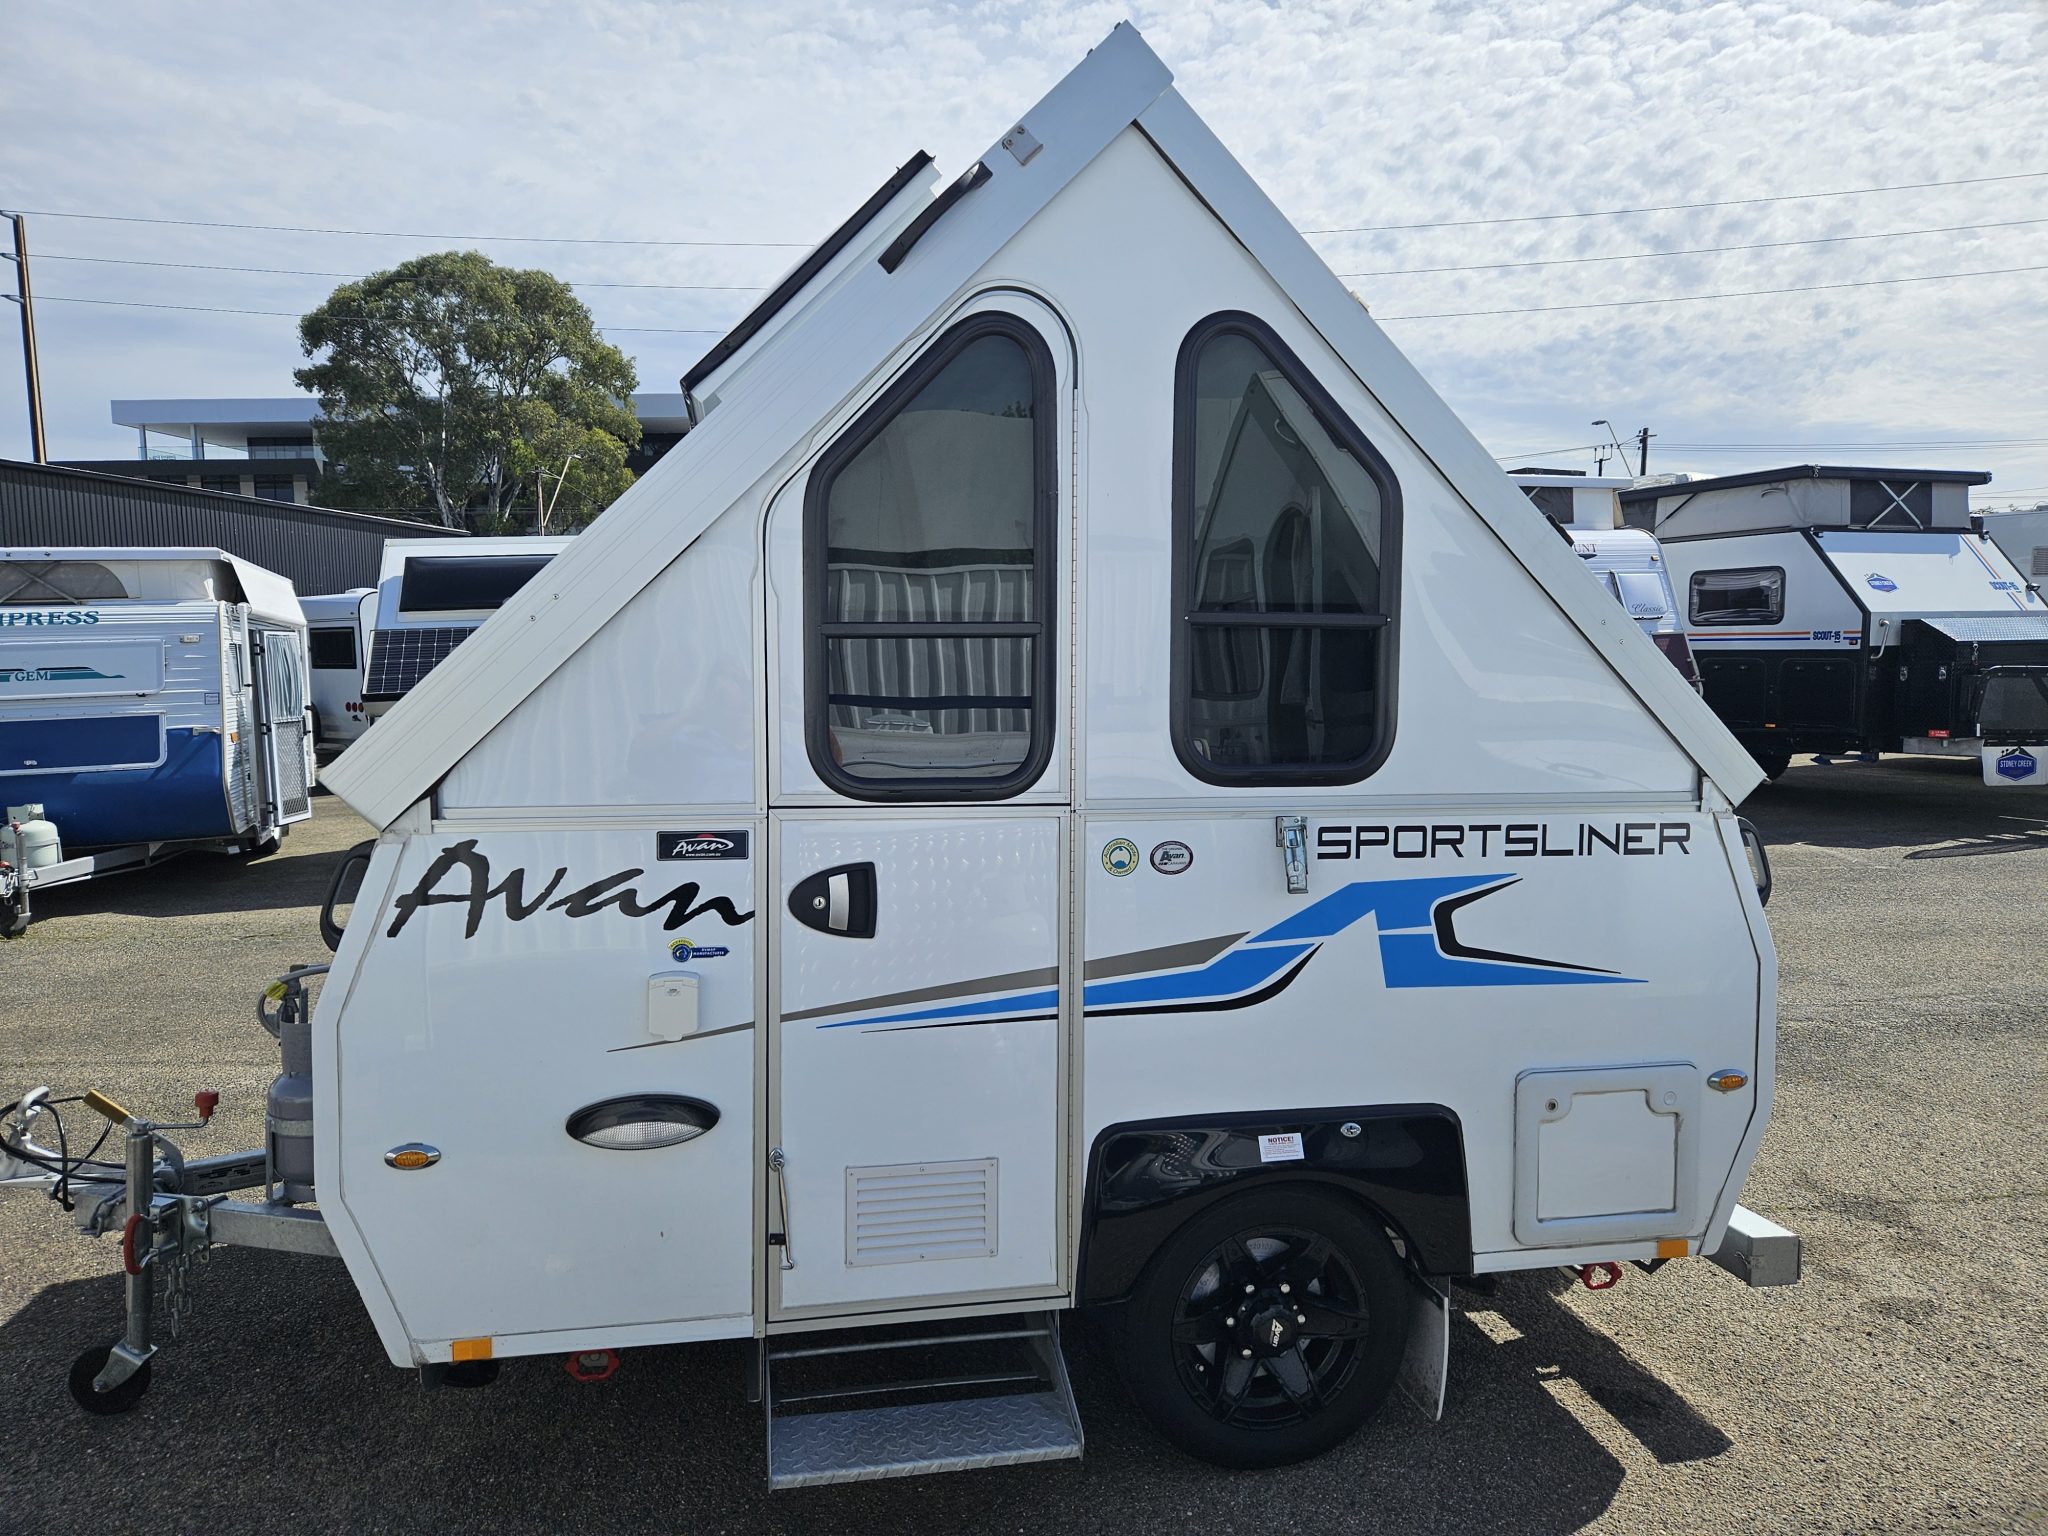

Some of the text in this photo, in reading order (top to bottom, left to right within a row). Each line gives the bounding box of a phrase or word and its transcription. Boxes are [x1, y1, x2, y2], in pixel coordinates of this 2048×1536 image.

[1574, 544, 1597, 553] UNT
[1632, 603, 1663, 613] Classic
[0, 611, 100, 626] PRESS
[1812, 630, 1841, 640] SCOUT-15
[15, 671, 49, 682] GEM
[1317, 822, 1691, 860] SPORTSLINER
[672, 840, 728, 856] Avan
[1159, 850, 1185, 862] Avan
[387, 838, 756, 940] Avan
[1271, 1318, 1284, 1348] Avan
